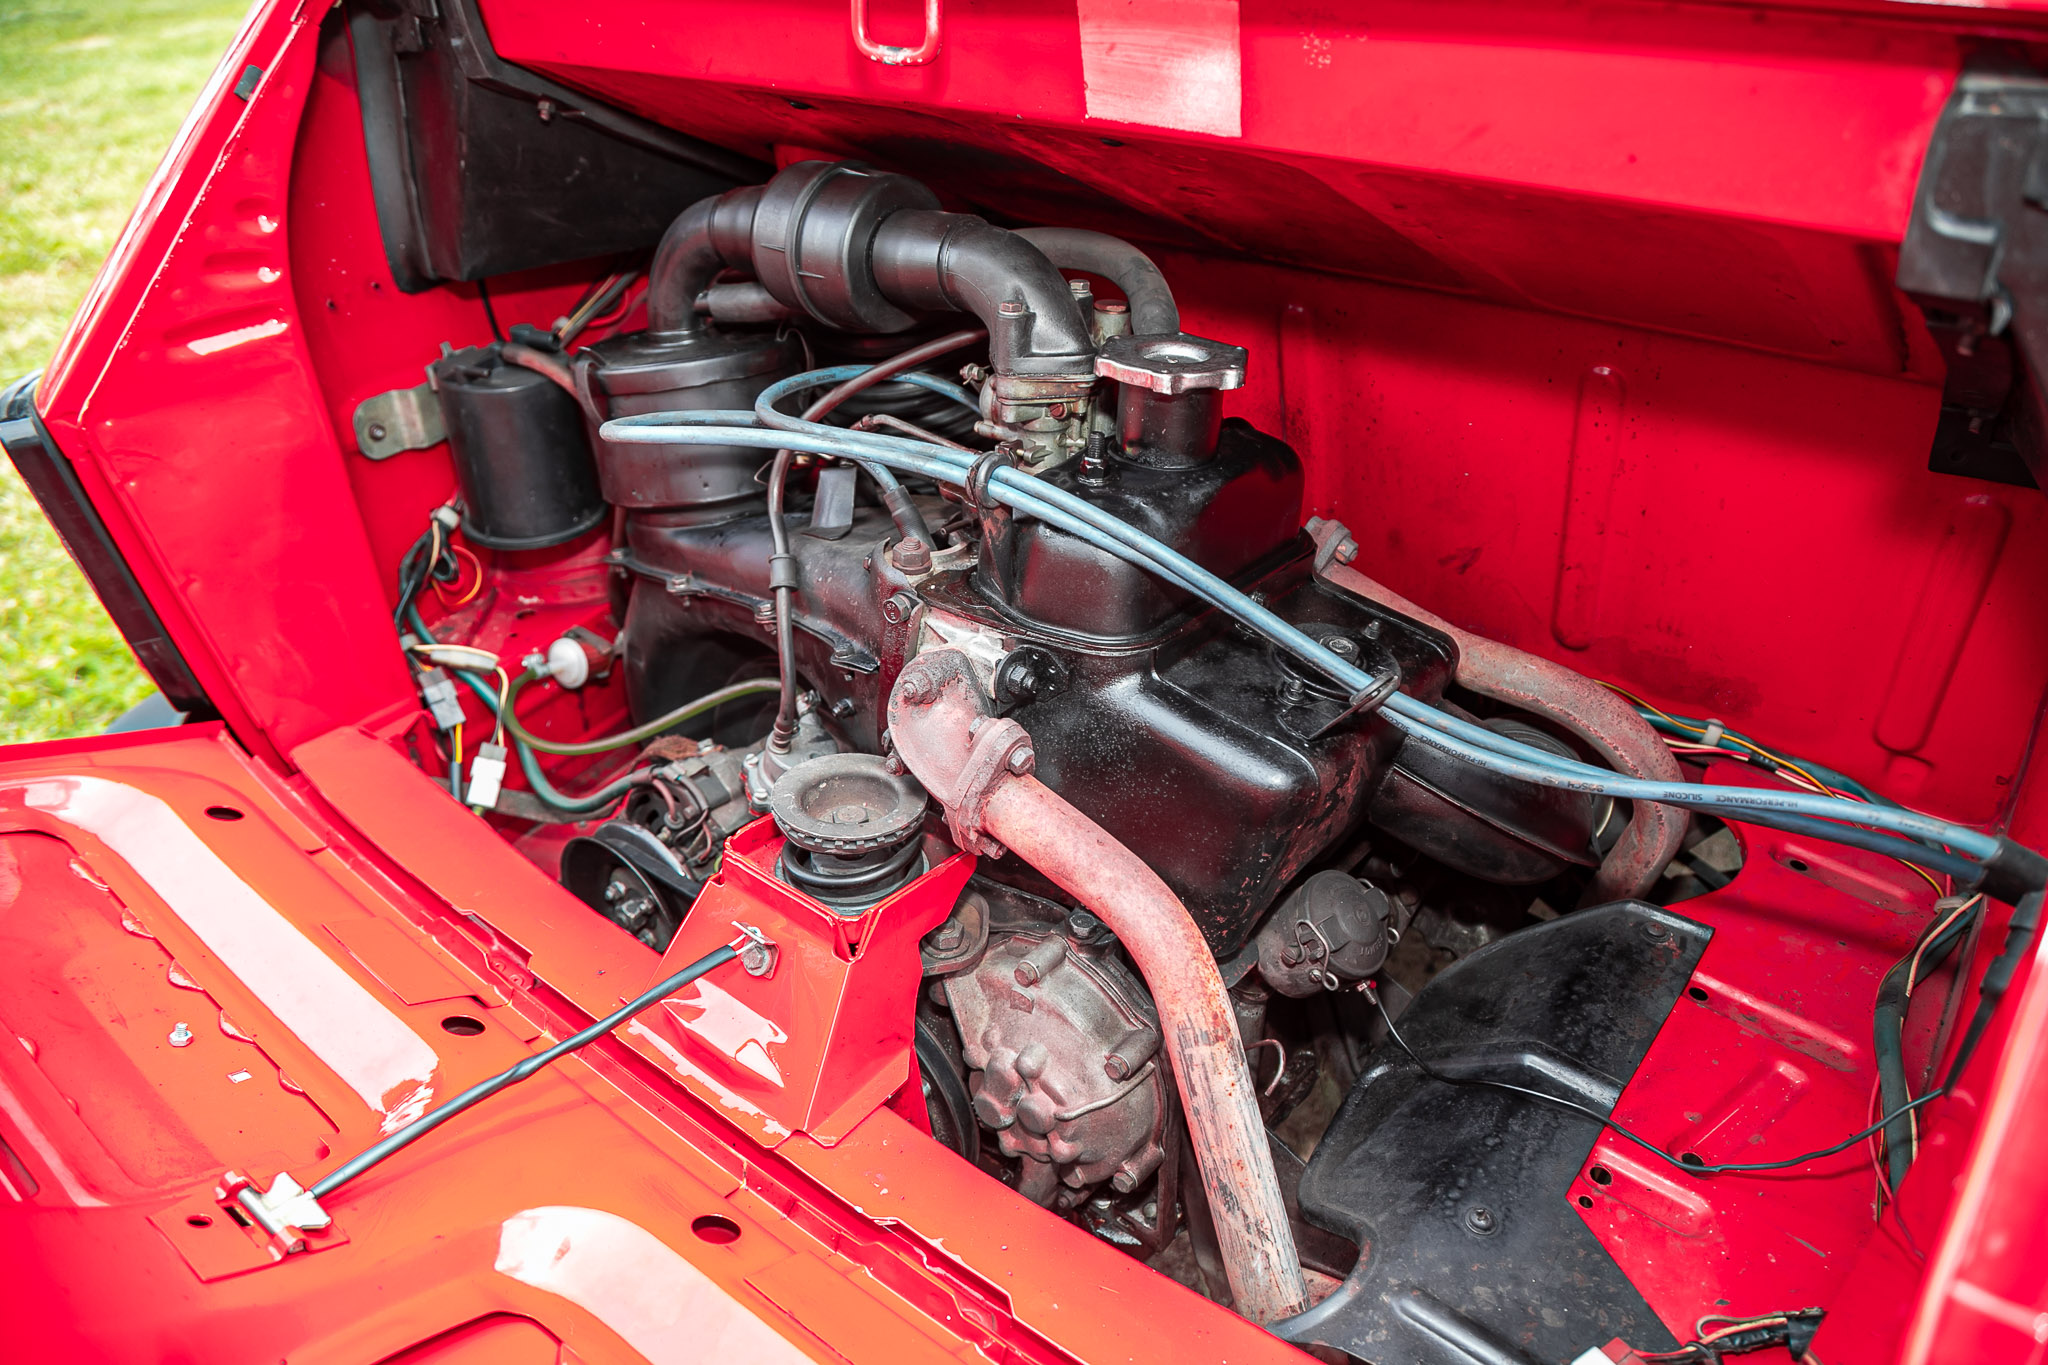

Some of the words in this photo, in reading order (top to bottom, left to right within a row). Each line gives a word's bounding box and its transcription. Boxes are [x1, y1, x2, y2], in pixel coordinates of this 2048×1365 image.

[1378, 709, 1411, 732] SILICONE
[1567, 781, 1605, 793] BOSCH
[1662, 791, 1703, 801] SILICONE
